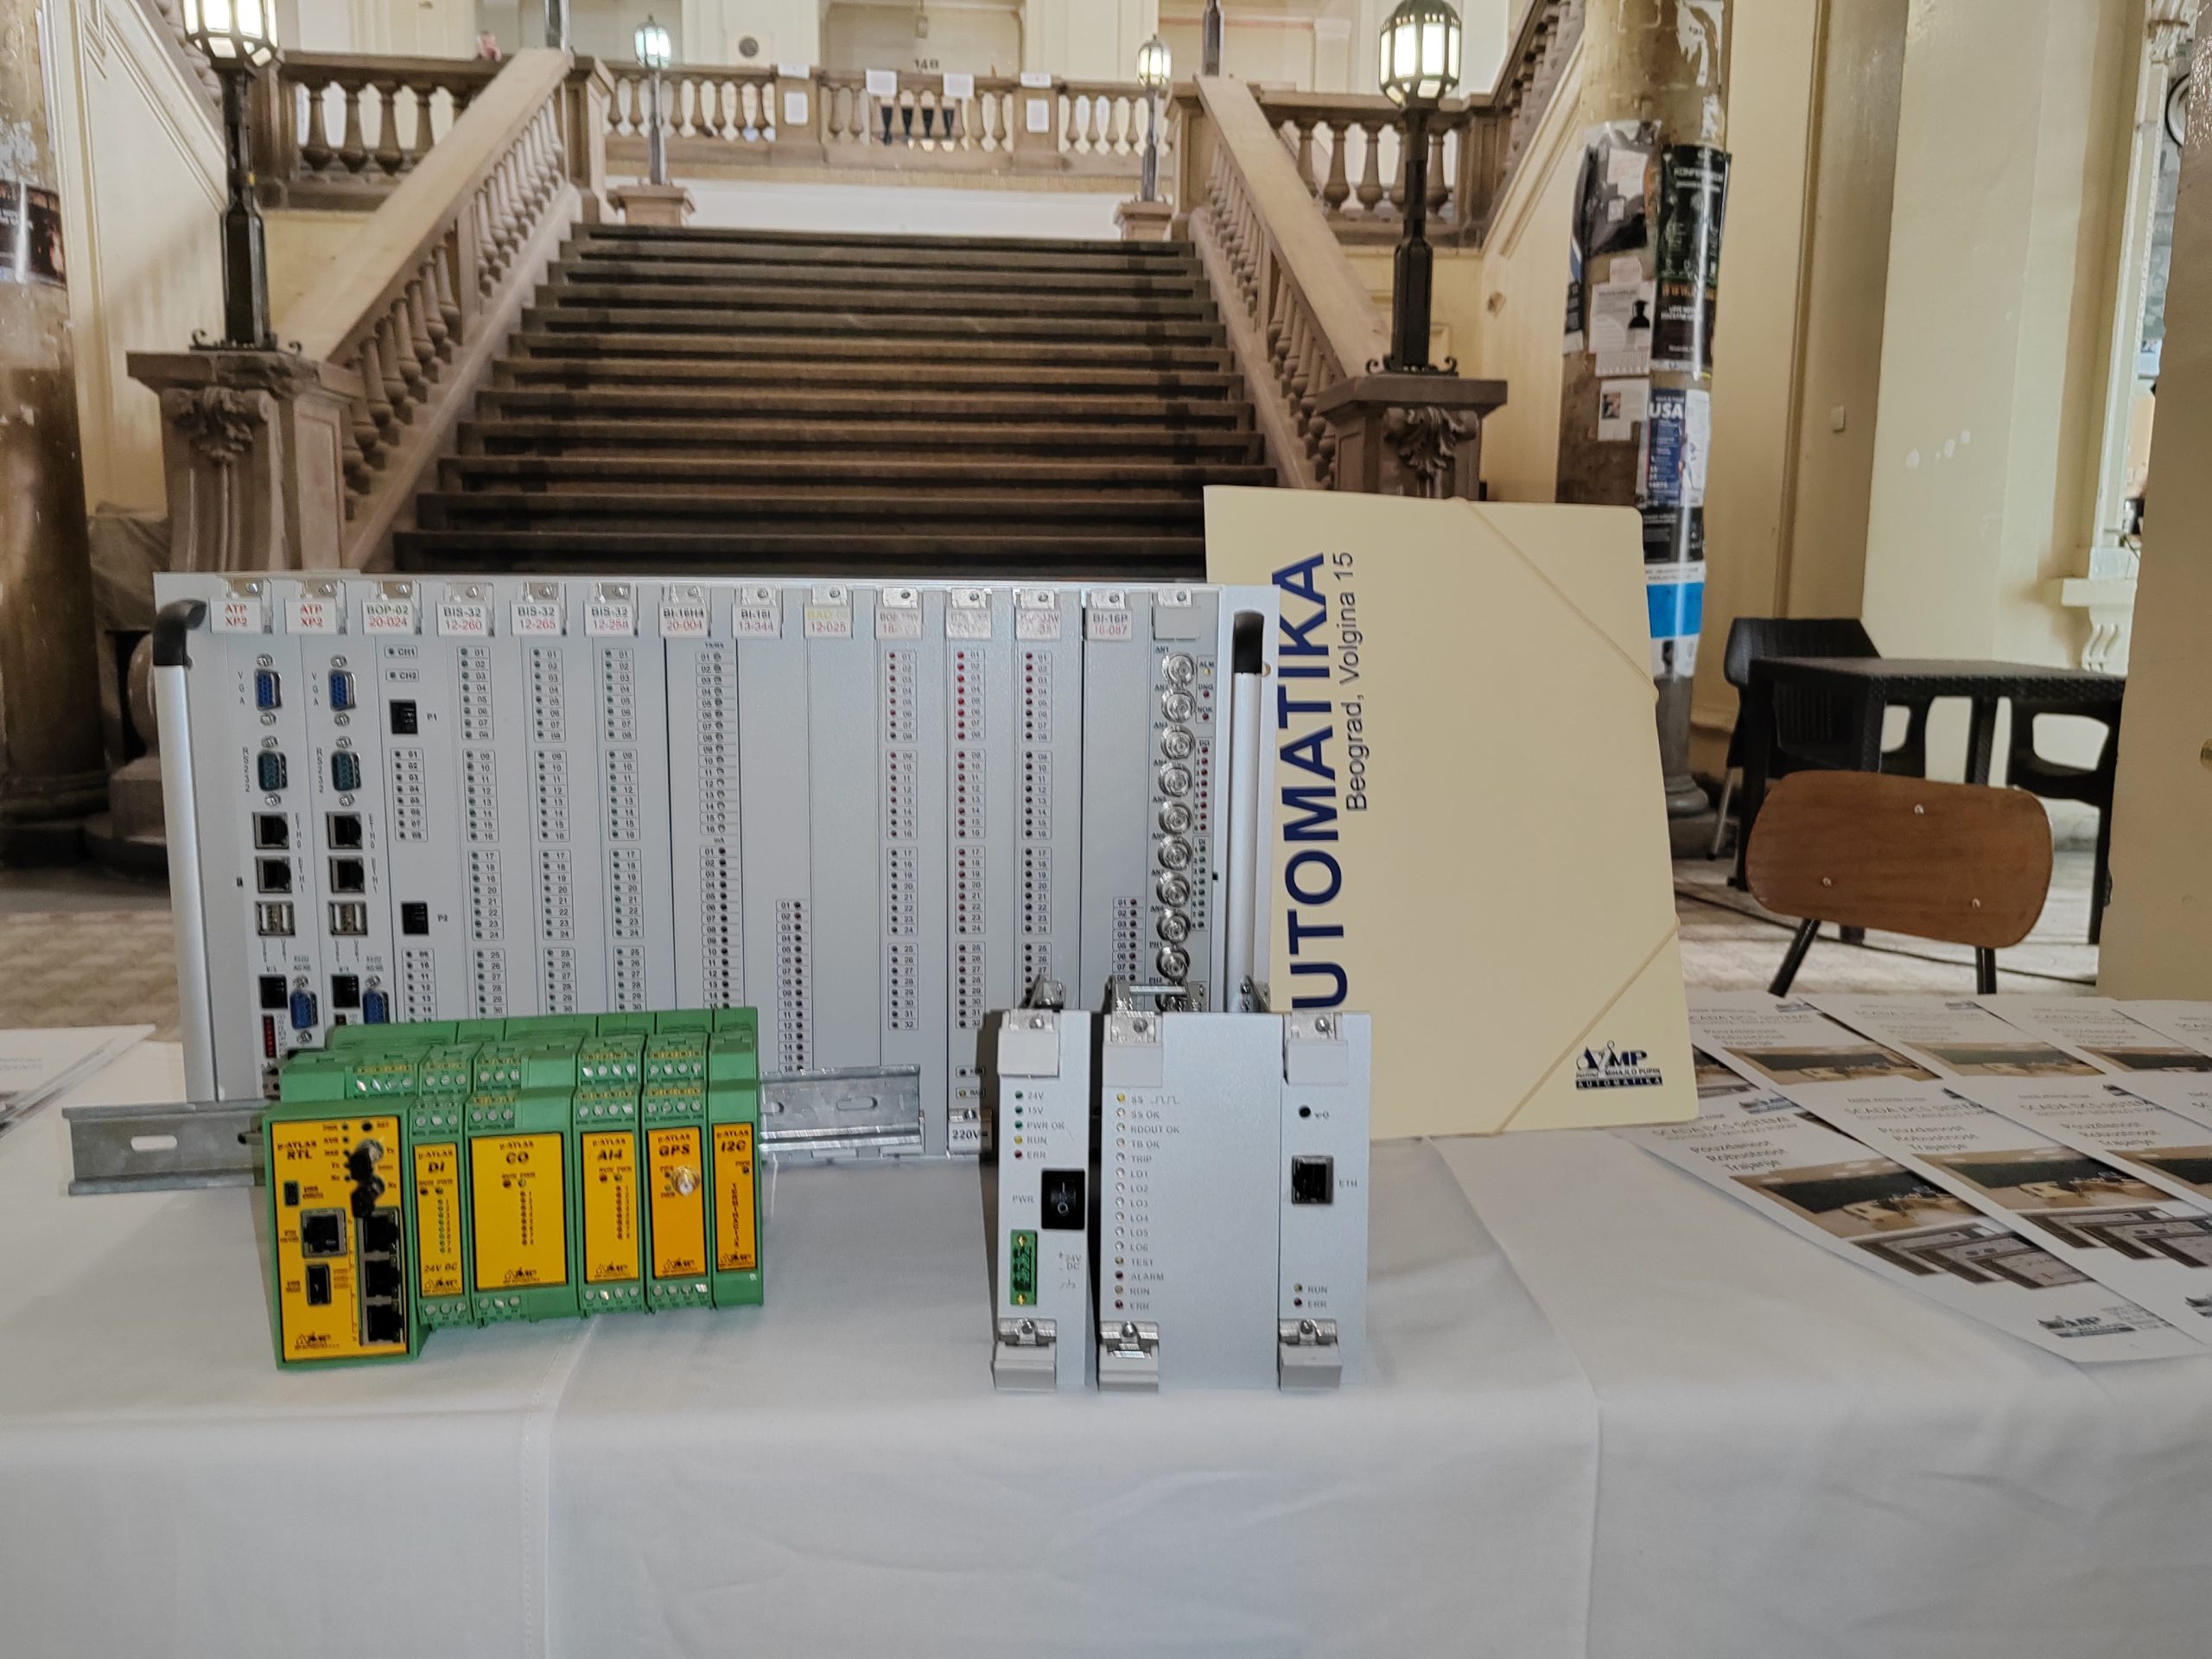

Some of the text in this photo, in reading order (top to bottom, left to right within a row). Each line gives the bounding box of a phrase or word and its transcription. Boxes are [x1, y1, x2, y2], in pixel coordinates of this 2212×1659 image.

[1648, 403, 1684, 419] USA
[225, 604, 247, 613] ATP
[301, 604, 323, 613] ATP
[443, 607, 481, 617] BIS-32
[518, 607, 555, 617] BIS-32
[591, 607, 628, 617] BIS-32
[226, 617, 248, 626] XP2
[301, 617, 324, 627] XP2
[369, 617, 408, 627] 20-024
[1332, 553, 1368, 811] Beograd, Volgina 15
[1272, 553, 1348, 1009] UTOMATIKA
[1577, 1077, 1662, 1089] AUTOMATIKA
[1146, 1110, 1160, 1120] OK
[1166, 1125, 1181, 1135] OK
[1146, 1140, 1160, 1149] OK
[658, 1144, 690, 1157] GPS
[1012, 1195, 1034, 1204] PWR
